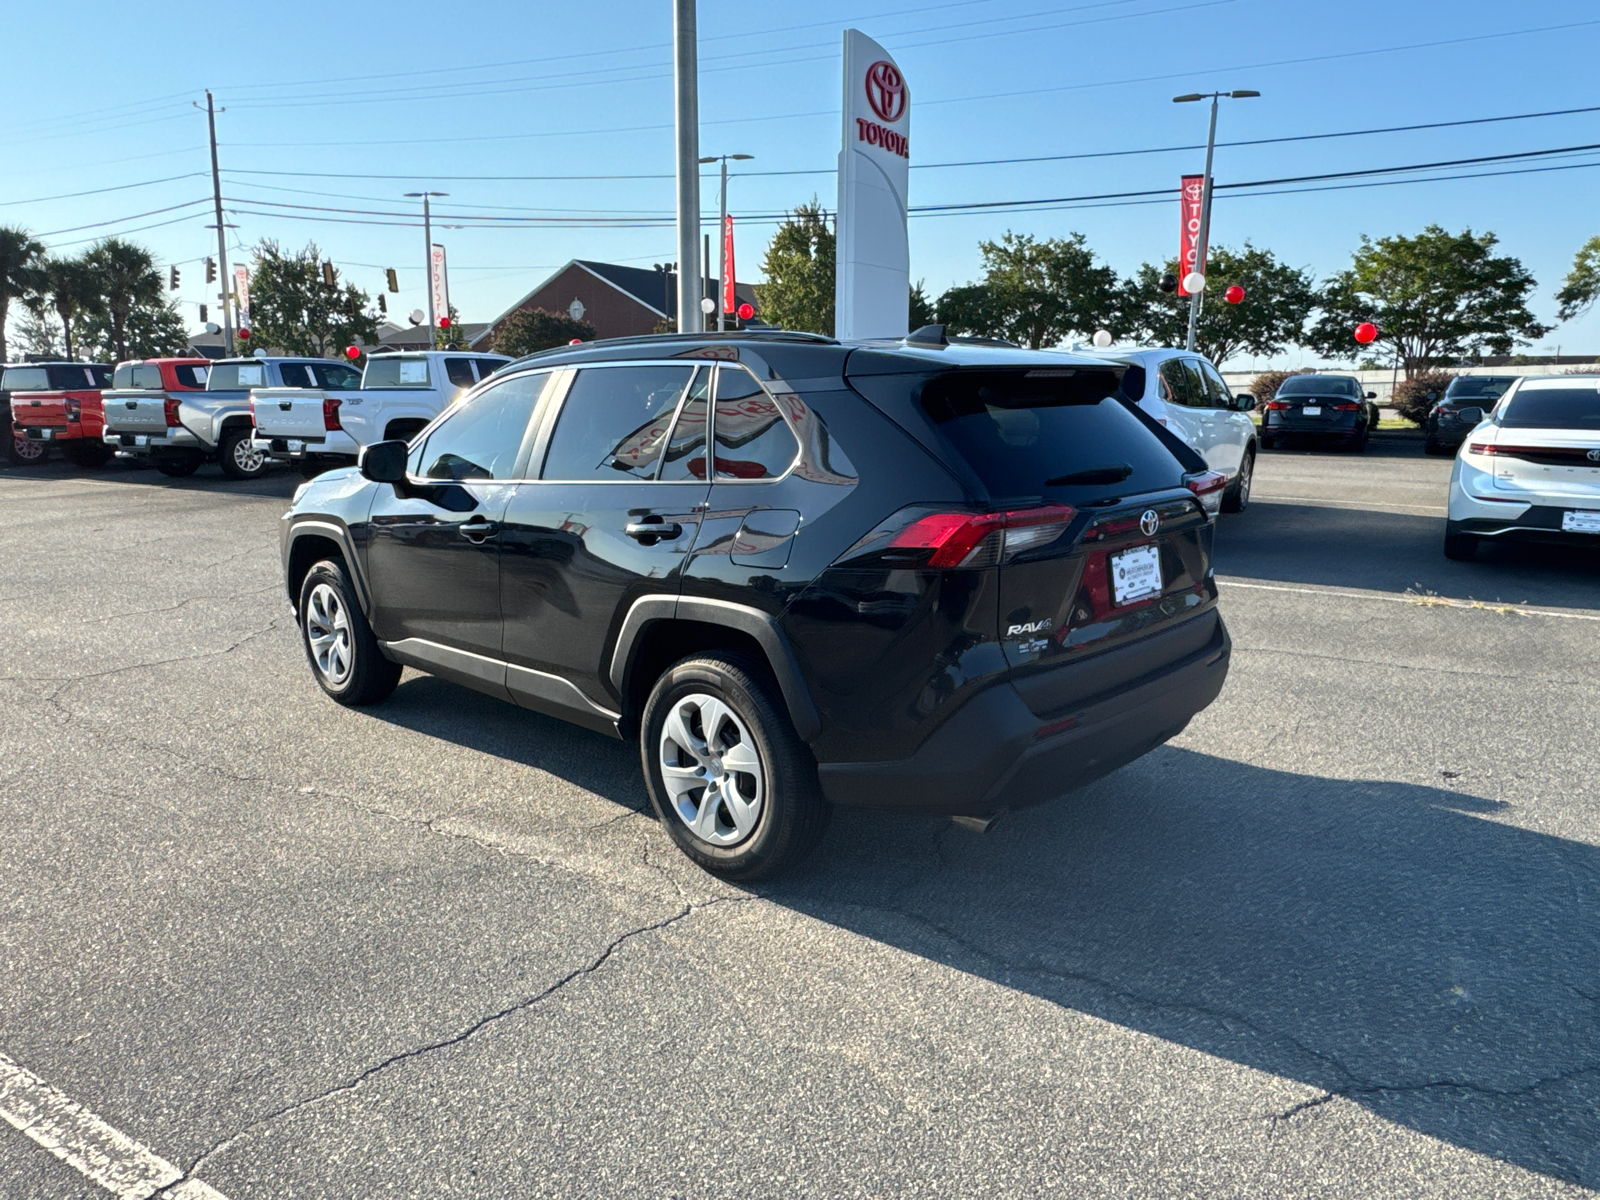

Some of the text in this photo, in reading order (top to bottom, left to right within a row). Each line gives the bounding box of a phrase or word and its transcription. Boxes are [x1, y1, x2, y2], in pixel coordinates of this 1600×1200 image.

[856, 118, 910, 159] TOYOTA
[1186, 203, 1201, 272] TOYO
[433, 264, 442, 321] TOYOTA
[1006, 617, 1052, 636] RAV4
